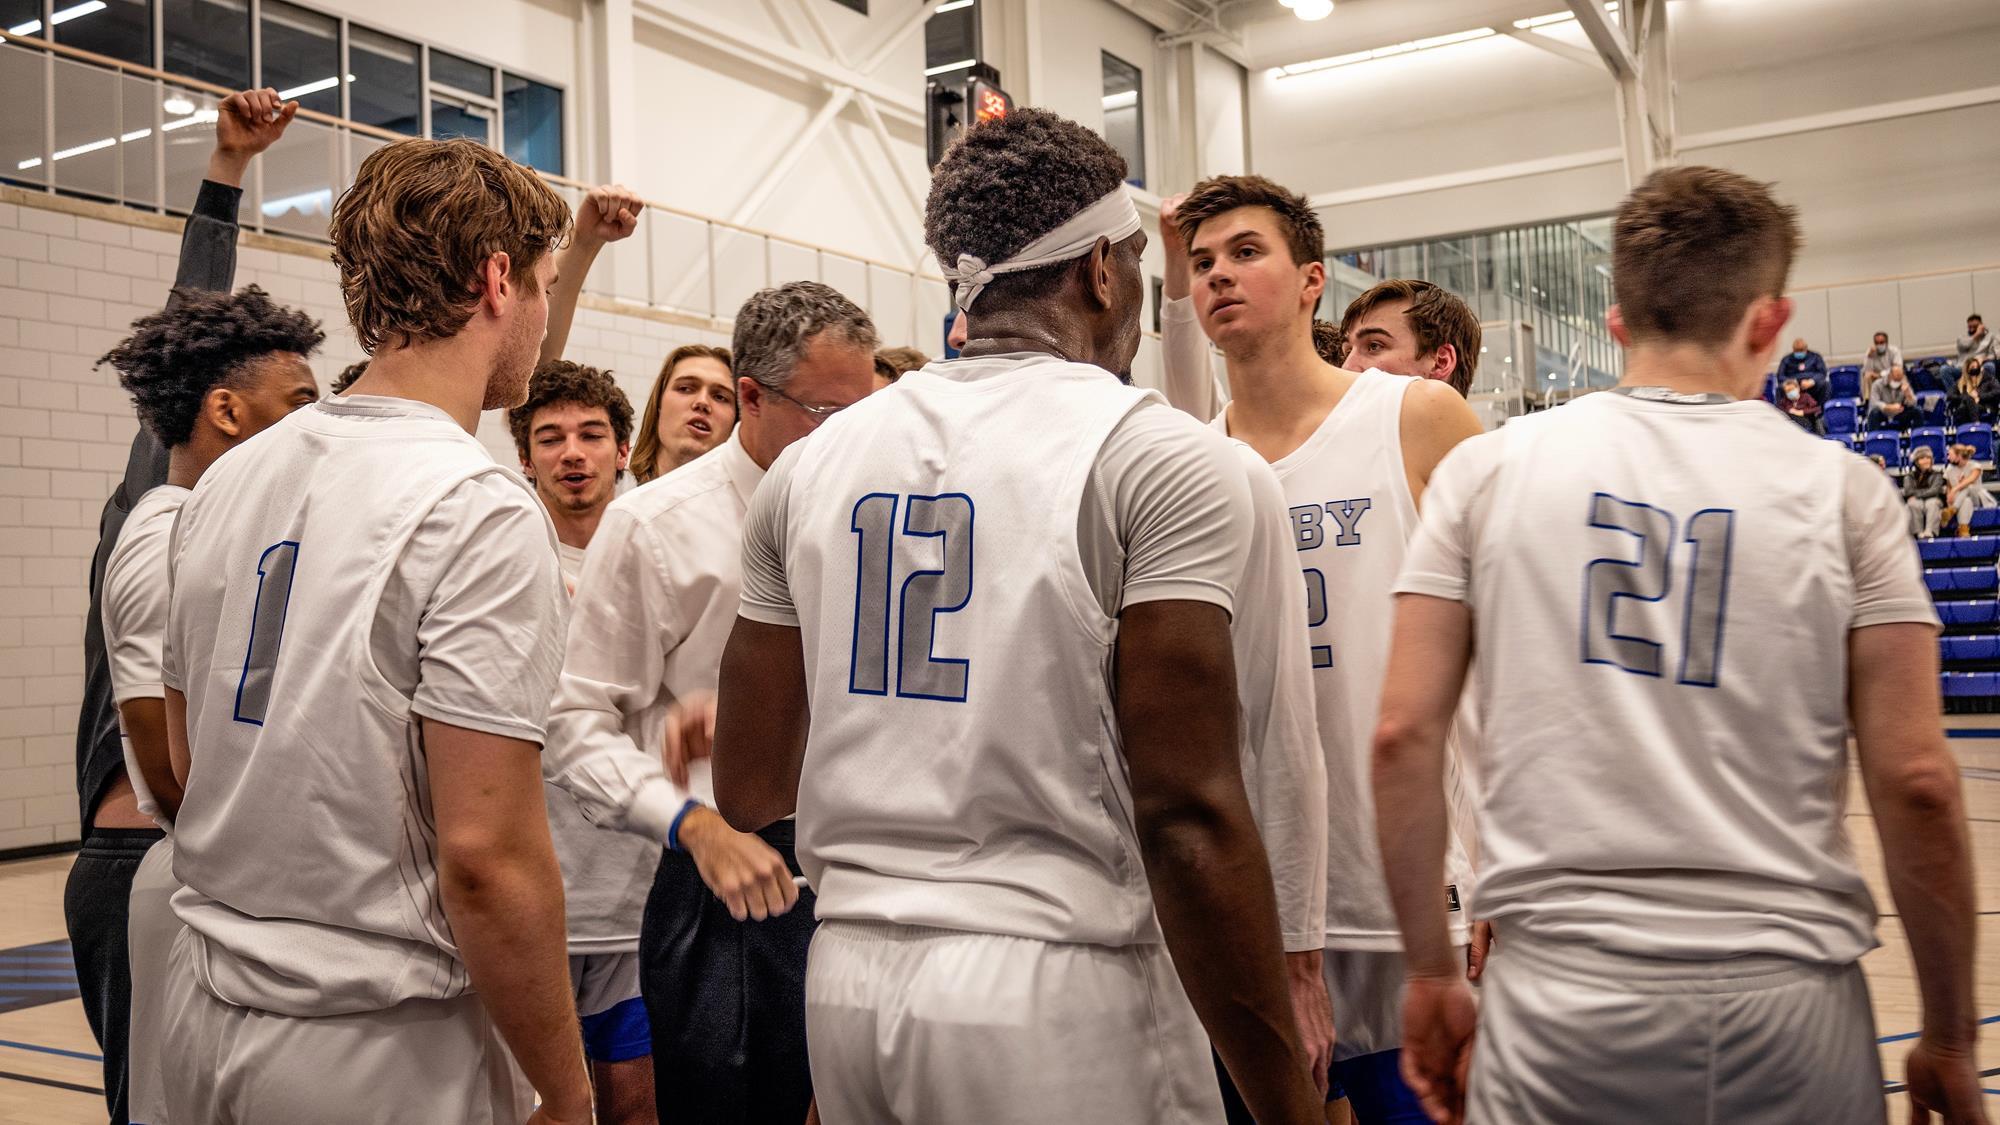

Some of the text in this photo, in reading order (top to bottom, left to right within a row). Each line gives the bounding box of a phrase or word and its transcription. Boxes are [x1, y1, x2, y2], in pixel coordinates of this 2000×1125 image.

[233, 540, 300, 727] 1
[848, 492, 975, 703] 12
[1580, 492, 1736, 688] 21
